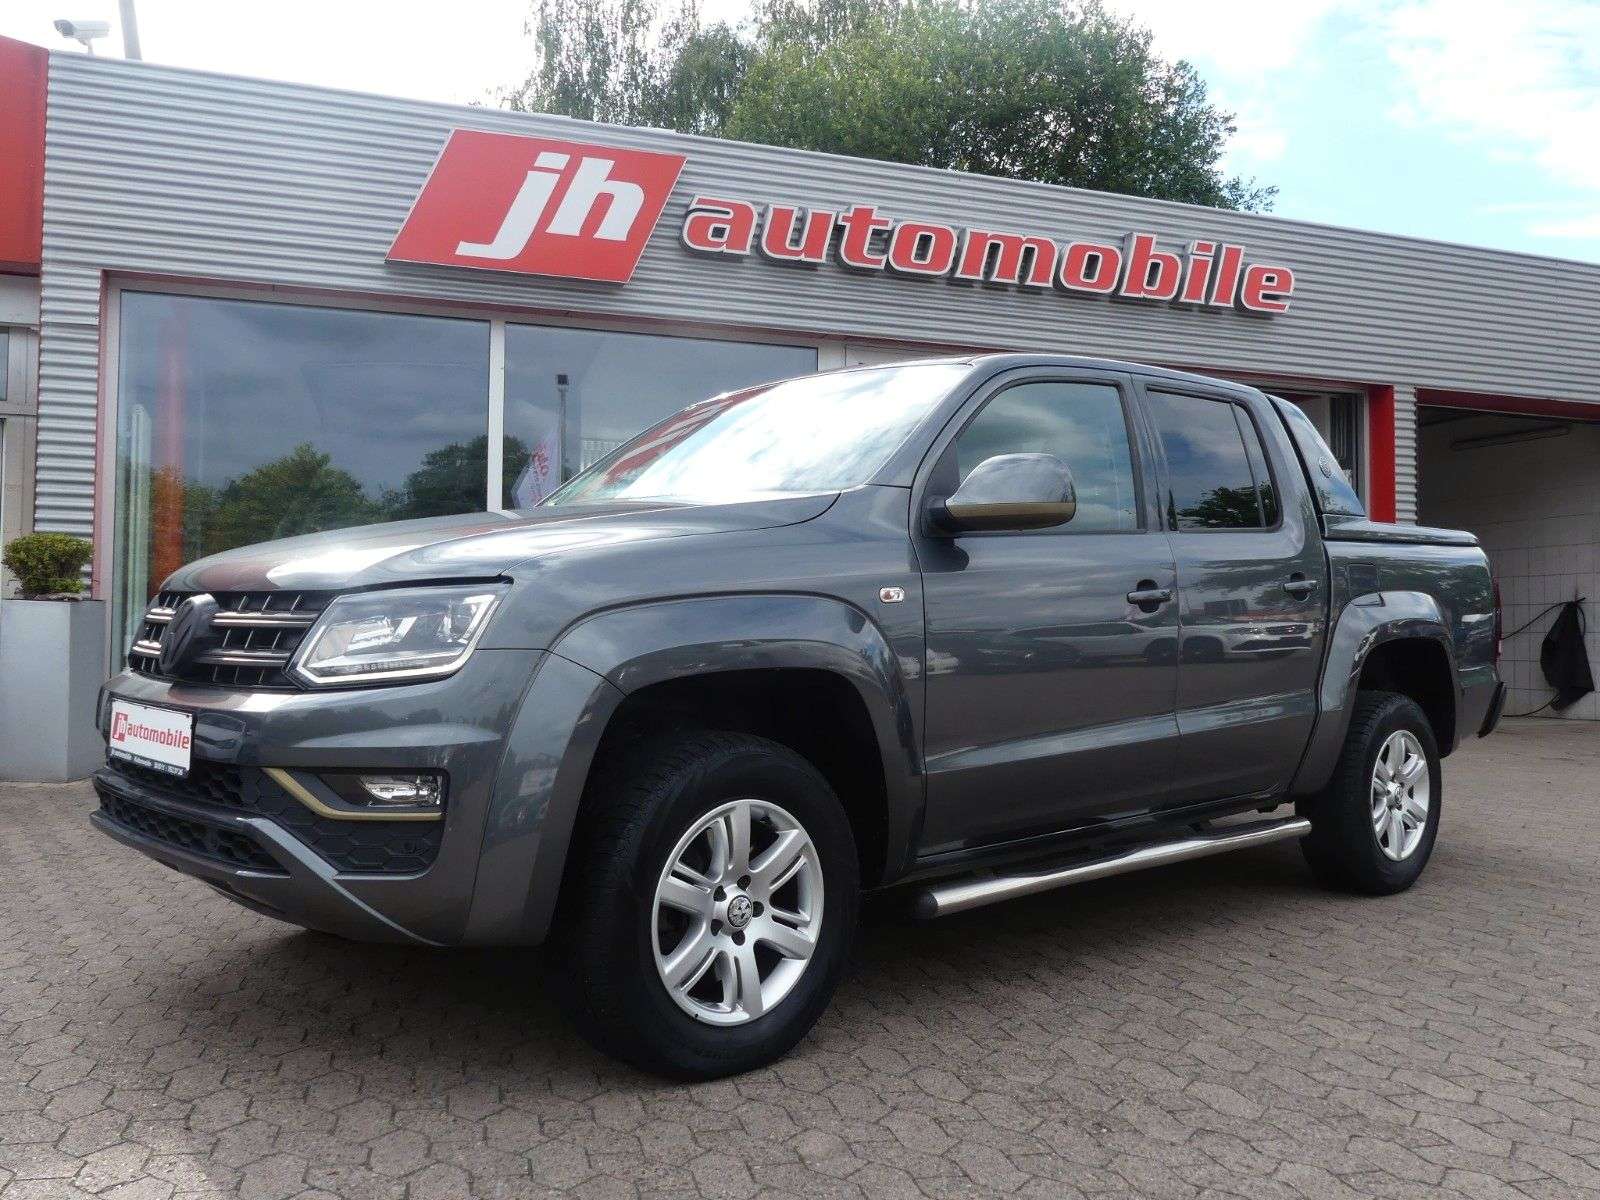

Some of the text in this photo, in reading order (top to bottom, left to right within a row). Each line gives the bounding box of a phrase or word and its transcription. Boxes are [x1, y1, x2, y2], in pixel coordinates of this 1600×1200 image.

[455, 151, 1295, 314] jh automobile
[127, 723, 190, 749] automobile
